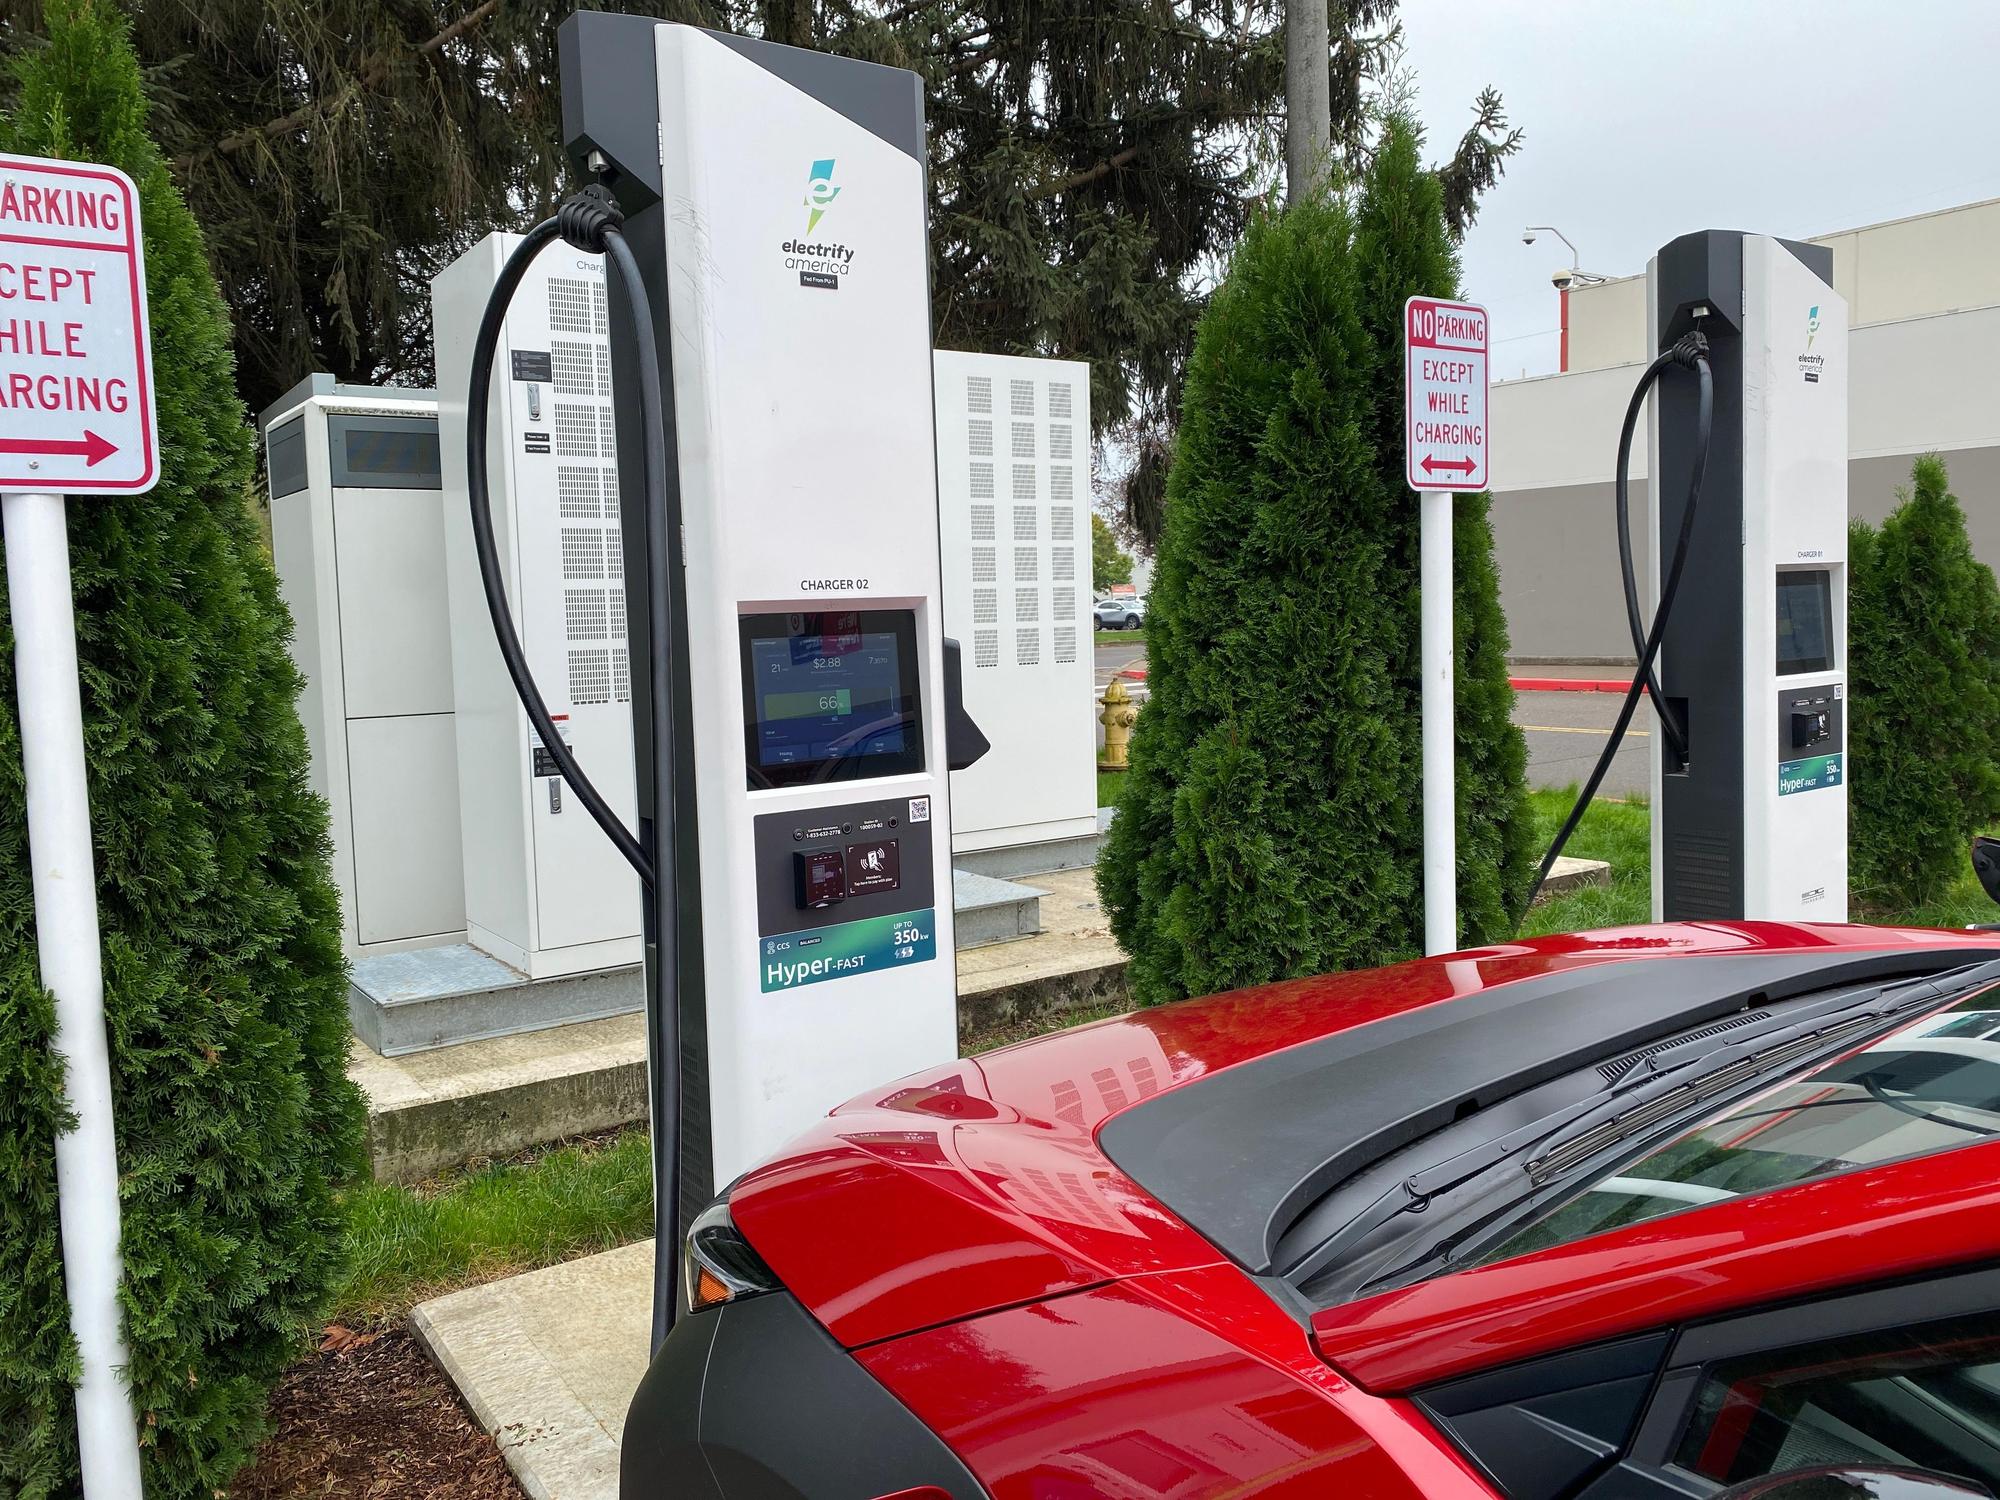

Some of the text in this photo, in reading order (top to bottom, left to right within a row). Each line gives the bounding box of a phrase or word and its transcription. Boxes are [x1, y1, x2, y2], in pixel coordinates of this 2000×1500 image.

[782, 239, 854, 263] electrify
[784, 257, 850, 275] america
[1413, 308, 1483, 341] NO PARKING
[1798, 353, 1824, 366] electrify
[1423, 359, 1474, 384] EXCEPT
[0, 374, 128, 413] RGING
[1428, 391, 1469, 414] WHILE
[1415, 421, 1482, 446] CHARGING
[800, 579, 869, 591] CHARGER 02
[771, 664, 781, 673] 21
[813, 657, 841, 669] $2.88
[893, 920, 913, 930] UP TO
[894, 928, 919, 945] 350
[776, 941, 791, 951] CCS
[767, 954, 866, 986] Hyper-FAST
